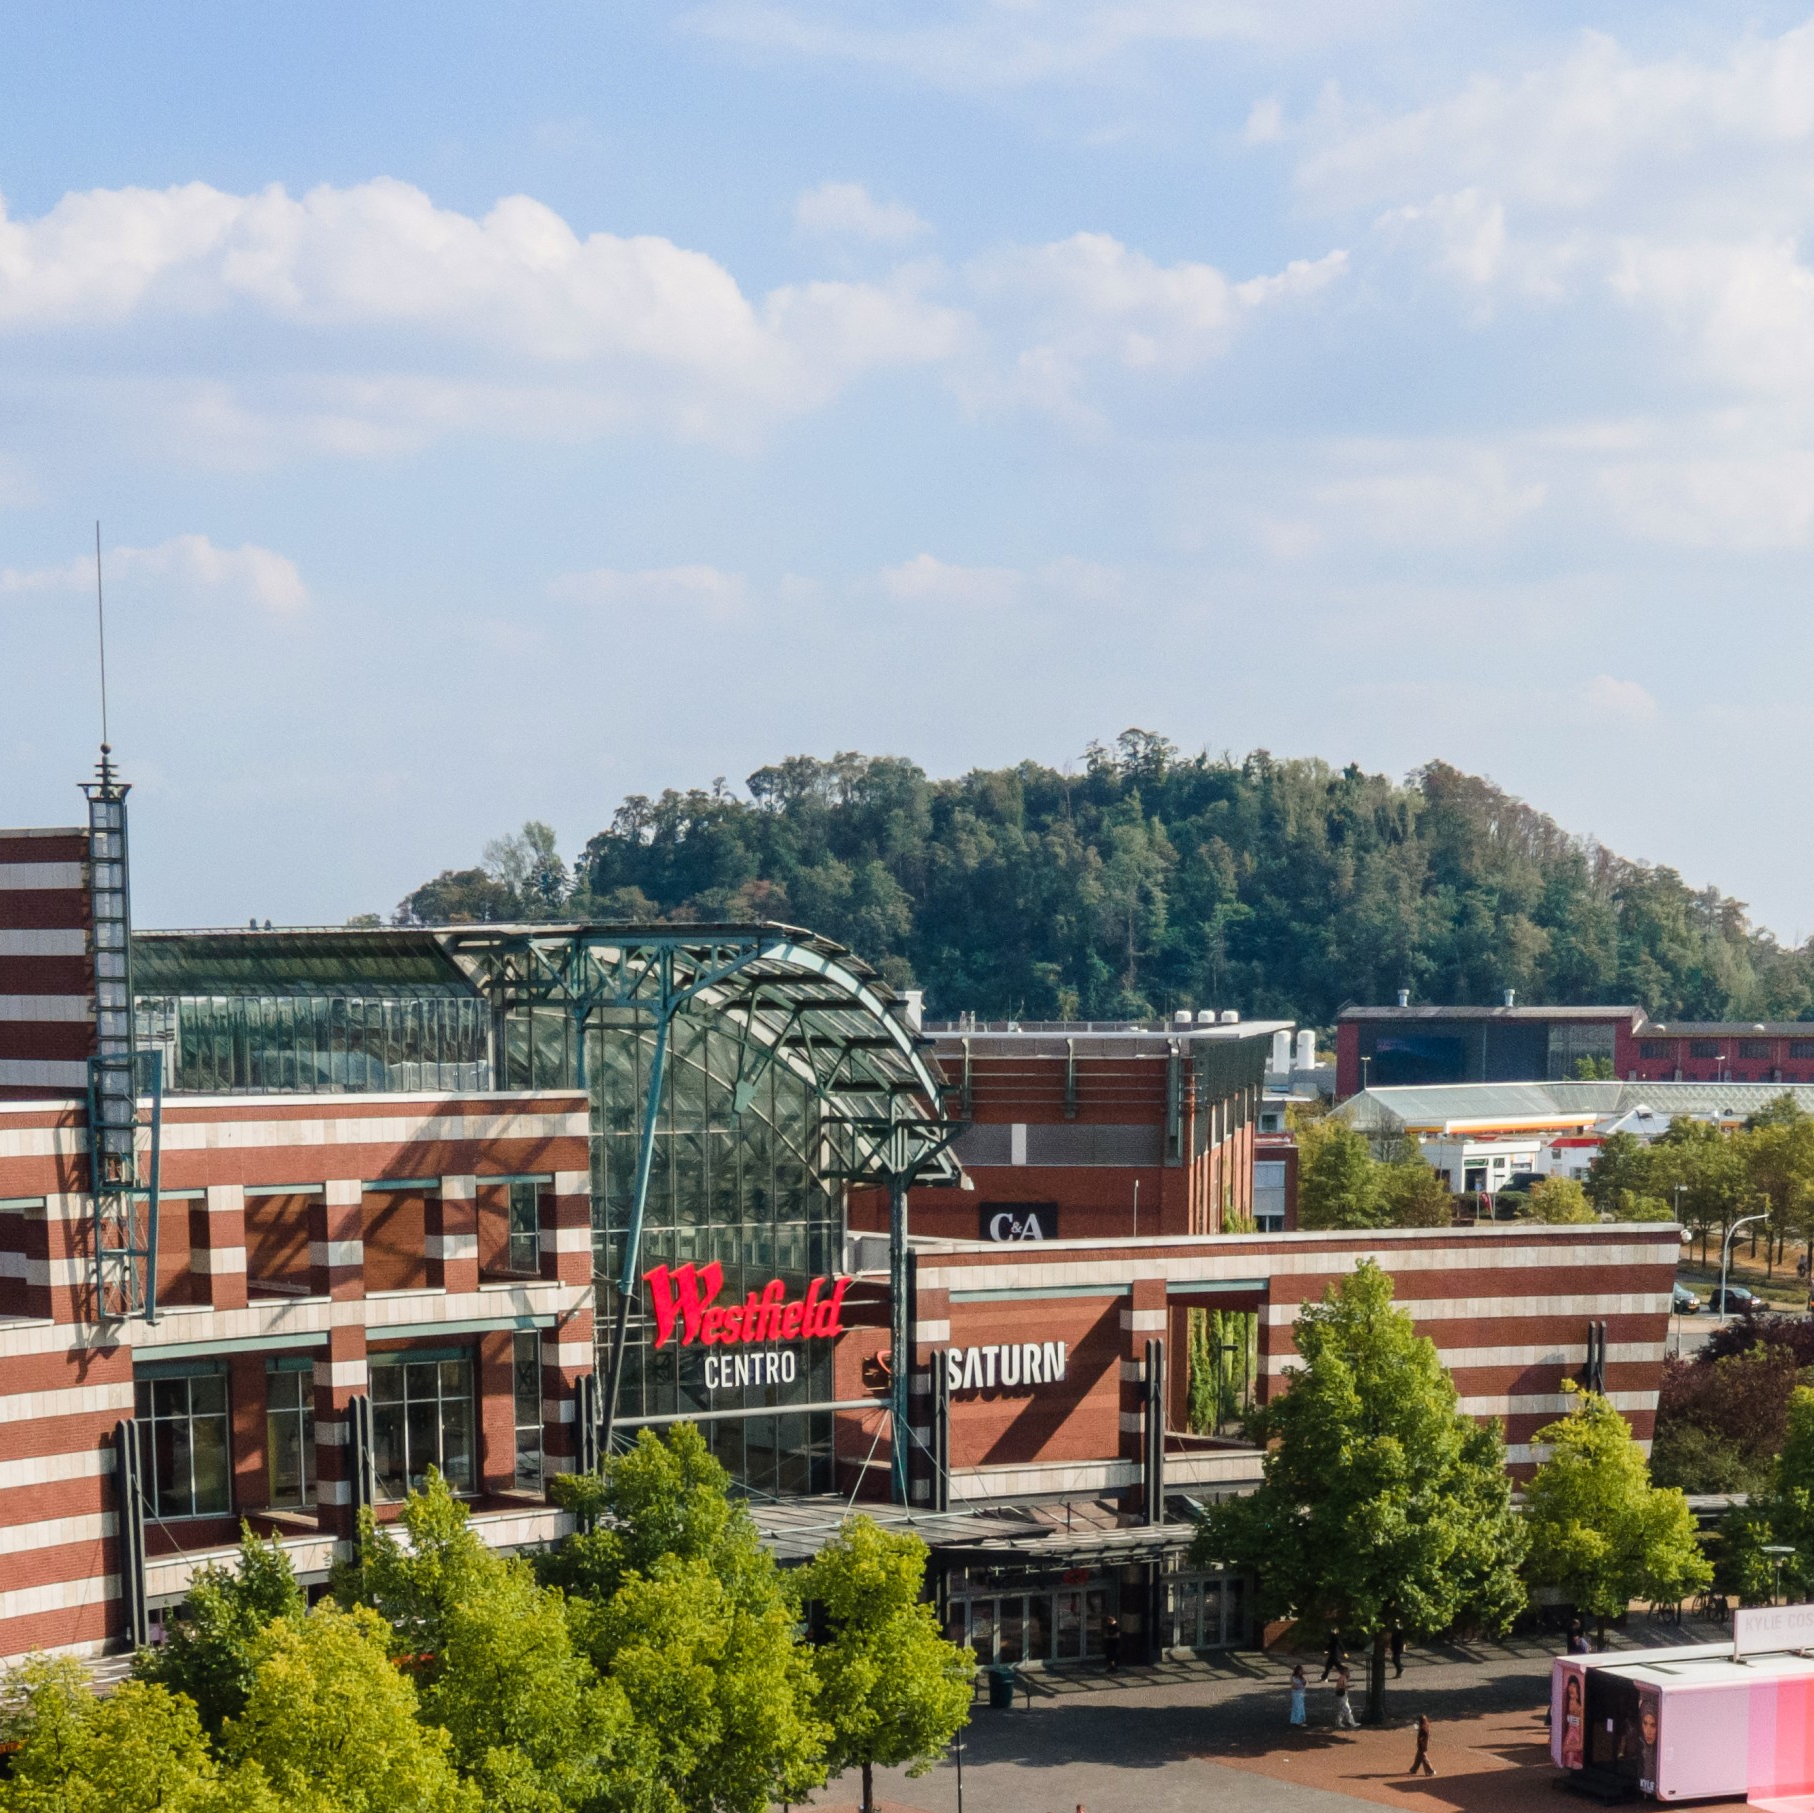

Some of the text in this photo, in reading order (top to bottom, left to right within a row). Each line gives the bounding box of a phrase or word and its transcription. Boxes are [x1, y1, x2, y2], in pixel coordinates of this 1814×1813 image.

[989, 1212, 1044, 1242] C&A
[642, 1259, 853, 1349] Westfield
[704, 1350, 795, 1389] CENTRO
[948, 1341, 1066, 1391] SATURN
[1745, 1615, 1783, 1632] KYLIE
